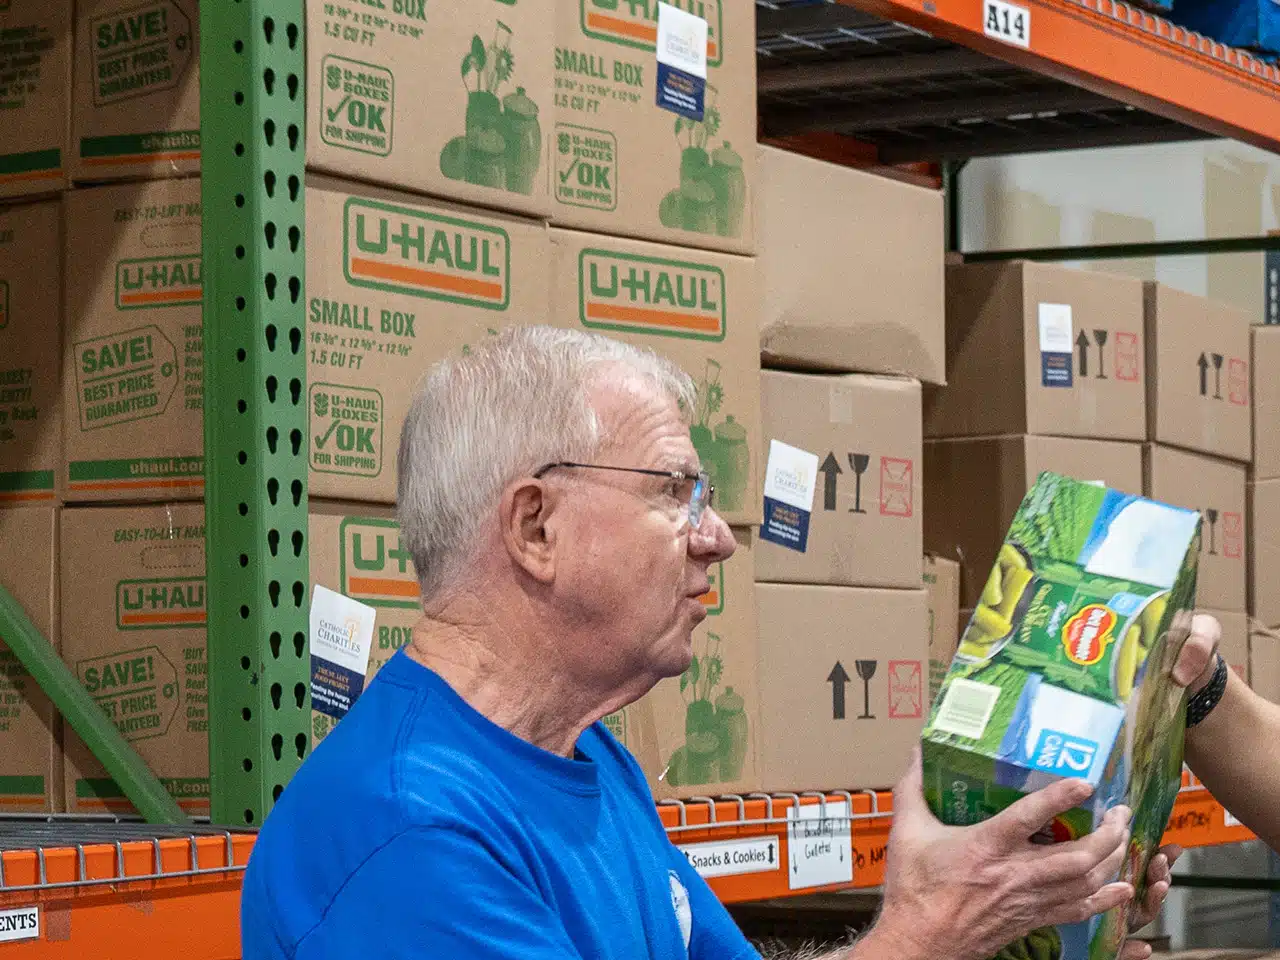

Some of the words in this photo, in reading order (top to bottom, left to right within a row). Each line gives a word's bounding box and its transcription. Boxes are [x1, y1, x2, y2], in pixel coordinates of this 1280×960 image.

[98, 10, 168, 48] SAVE!
[986, 2, 1024, 39] A14
[555, 47, 608, 79] SMALL
[614, 60, 644, 87] BOX
[344, 82, 389, 101] BOXES
[348, 100, 386, 133] OK
[578, 163, 612, 190] OK
[356, 213, 500, 277] U-HAUL
[590, 262, 717, 312] U-HAUL
[310, 298, 373, 334] SMALL
[380, 309, 416, 338] BOX
[81, 336, 153, 373] SAVE!
[311, 349, 326, 364] 1.5
[331, 352, 345, 368] CU
[349, 355, 363, 369] FT
[83, 383, 115, 402] BEST
[118, 373, 154, 394] PRICE
[86, 391, 158, 422] GUARANTEED
[331, 395, 377, 411] U-HAUL
[331, 408, 378, 423] BOXES
[336, 424, 375, 454] OK
[313, 453, 331, 466] FOR
[334, 454, 376, 469] SHIPPING
[318, 627, 361, 653] CHARITIES
[319, 619, 349, 638] CATHOLIC
[378, 625, 412, 650] BOX
[85, 656, 154, 693] SAVE!
[121, 693, 156, 715] PRICE
[1036, 734, 1062, 769] CANS
[1056, 740, 1092, 771] 12
[692, 855, 722, 869] Snacks
[724, 853, 731, 865] &
[733, 849, 766, 863] Cookies
